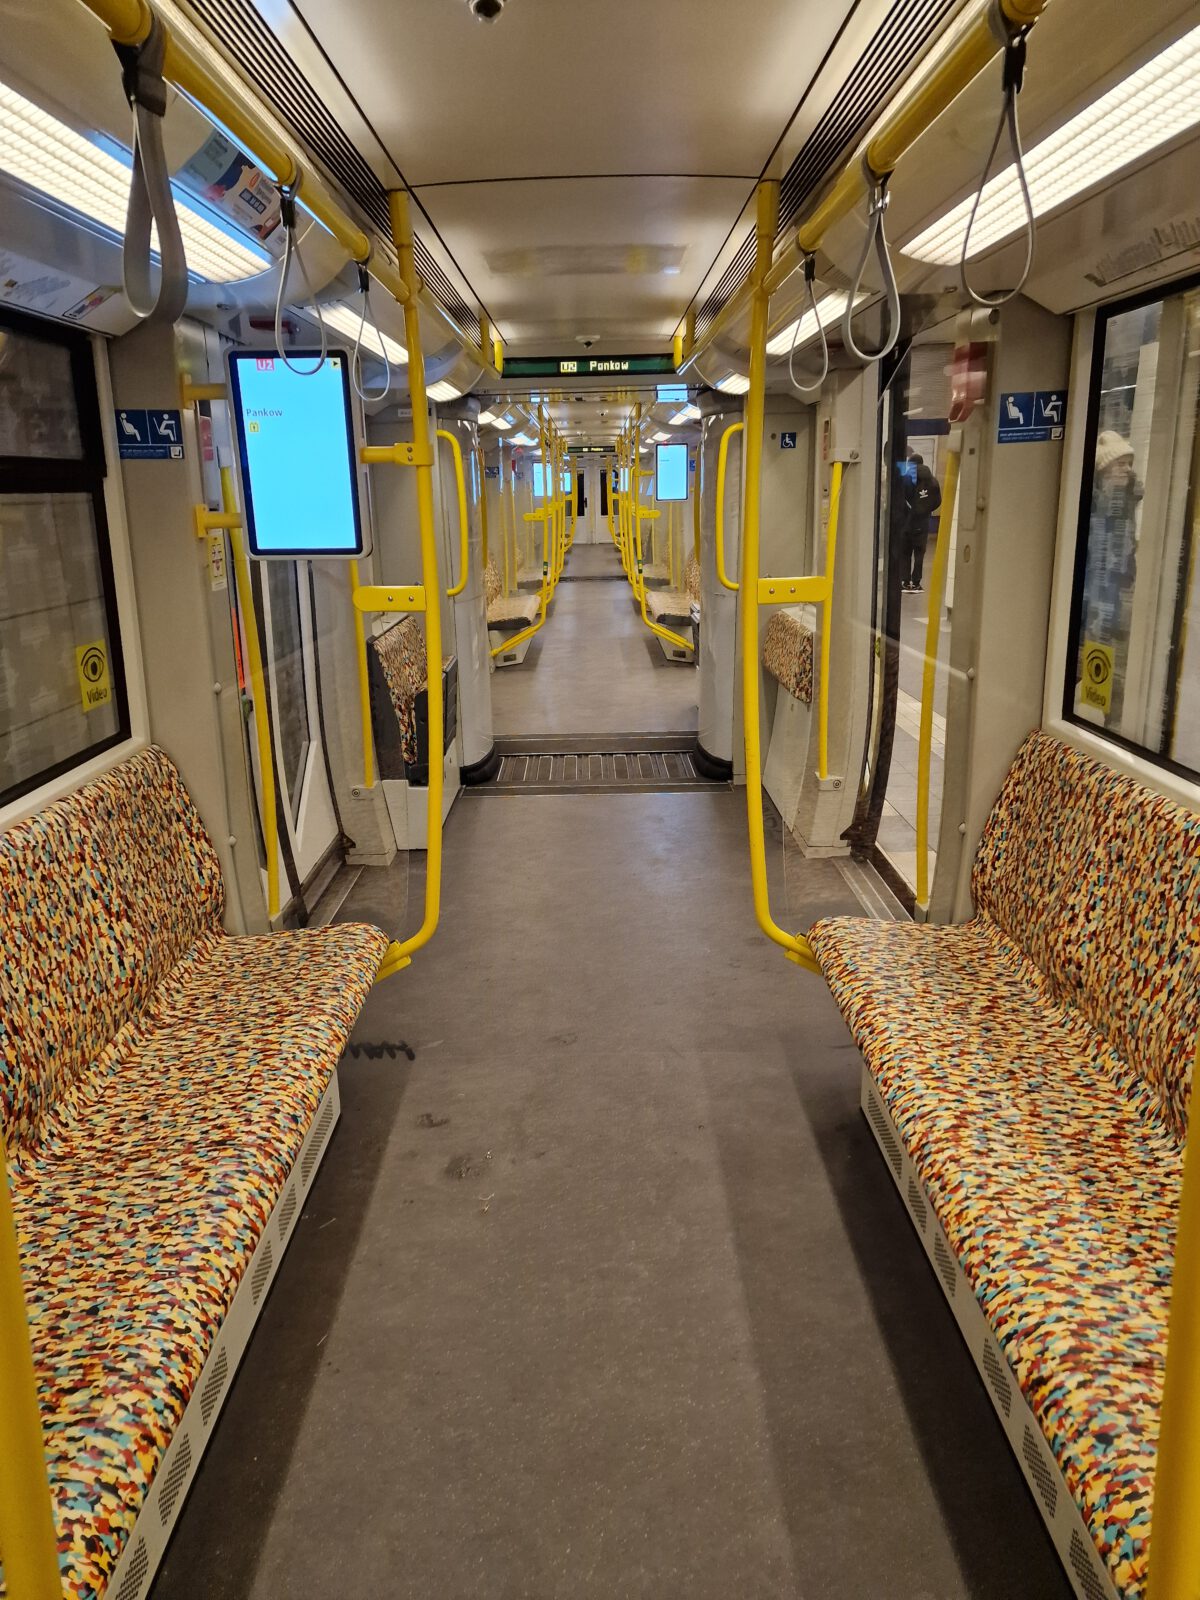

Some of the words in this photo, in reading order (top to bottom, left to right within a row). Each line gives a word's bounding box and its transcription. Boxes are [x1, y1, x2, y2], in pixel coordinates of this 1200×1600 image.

[258, 360, 273, 370] U2
[589, 360, 629, 371] Pankow
[245, 408, 283, 417] Pankow
[86, 687, 108, 704] Video
[1085, 685, 1106, 706] Video
